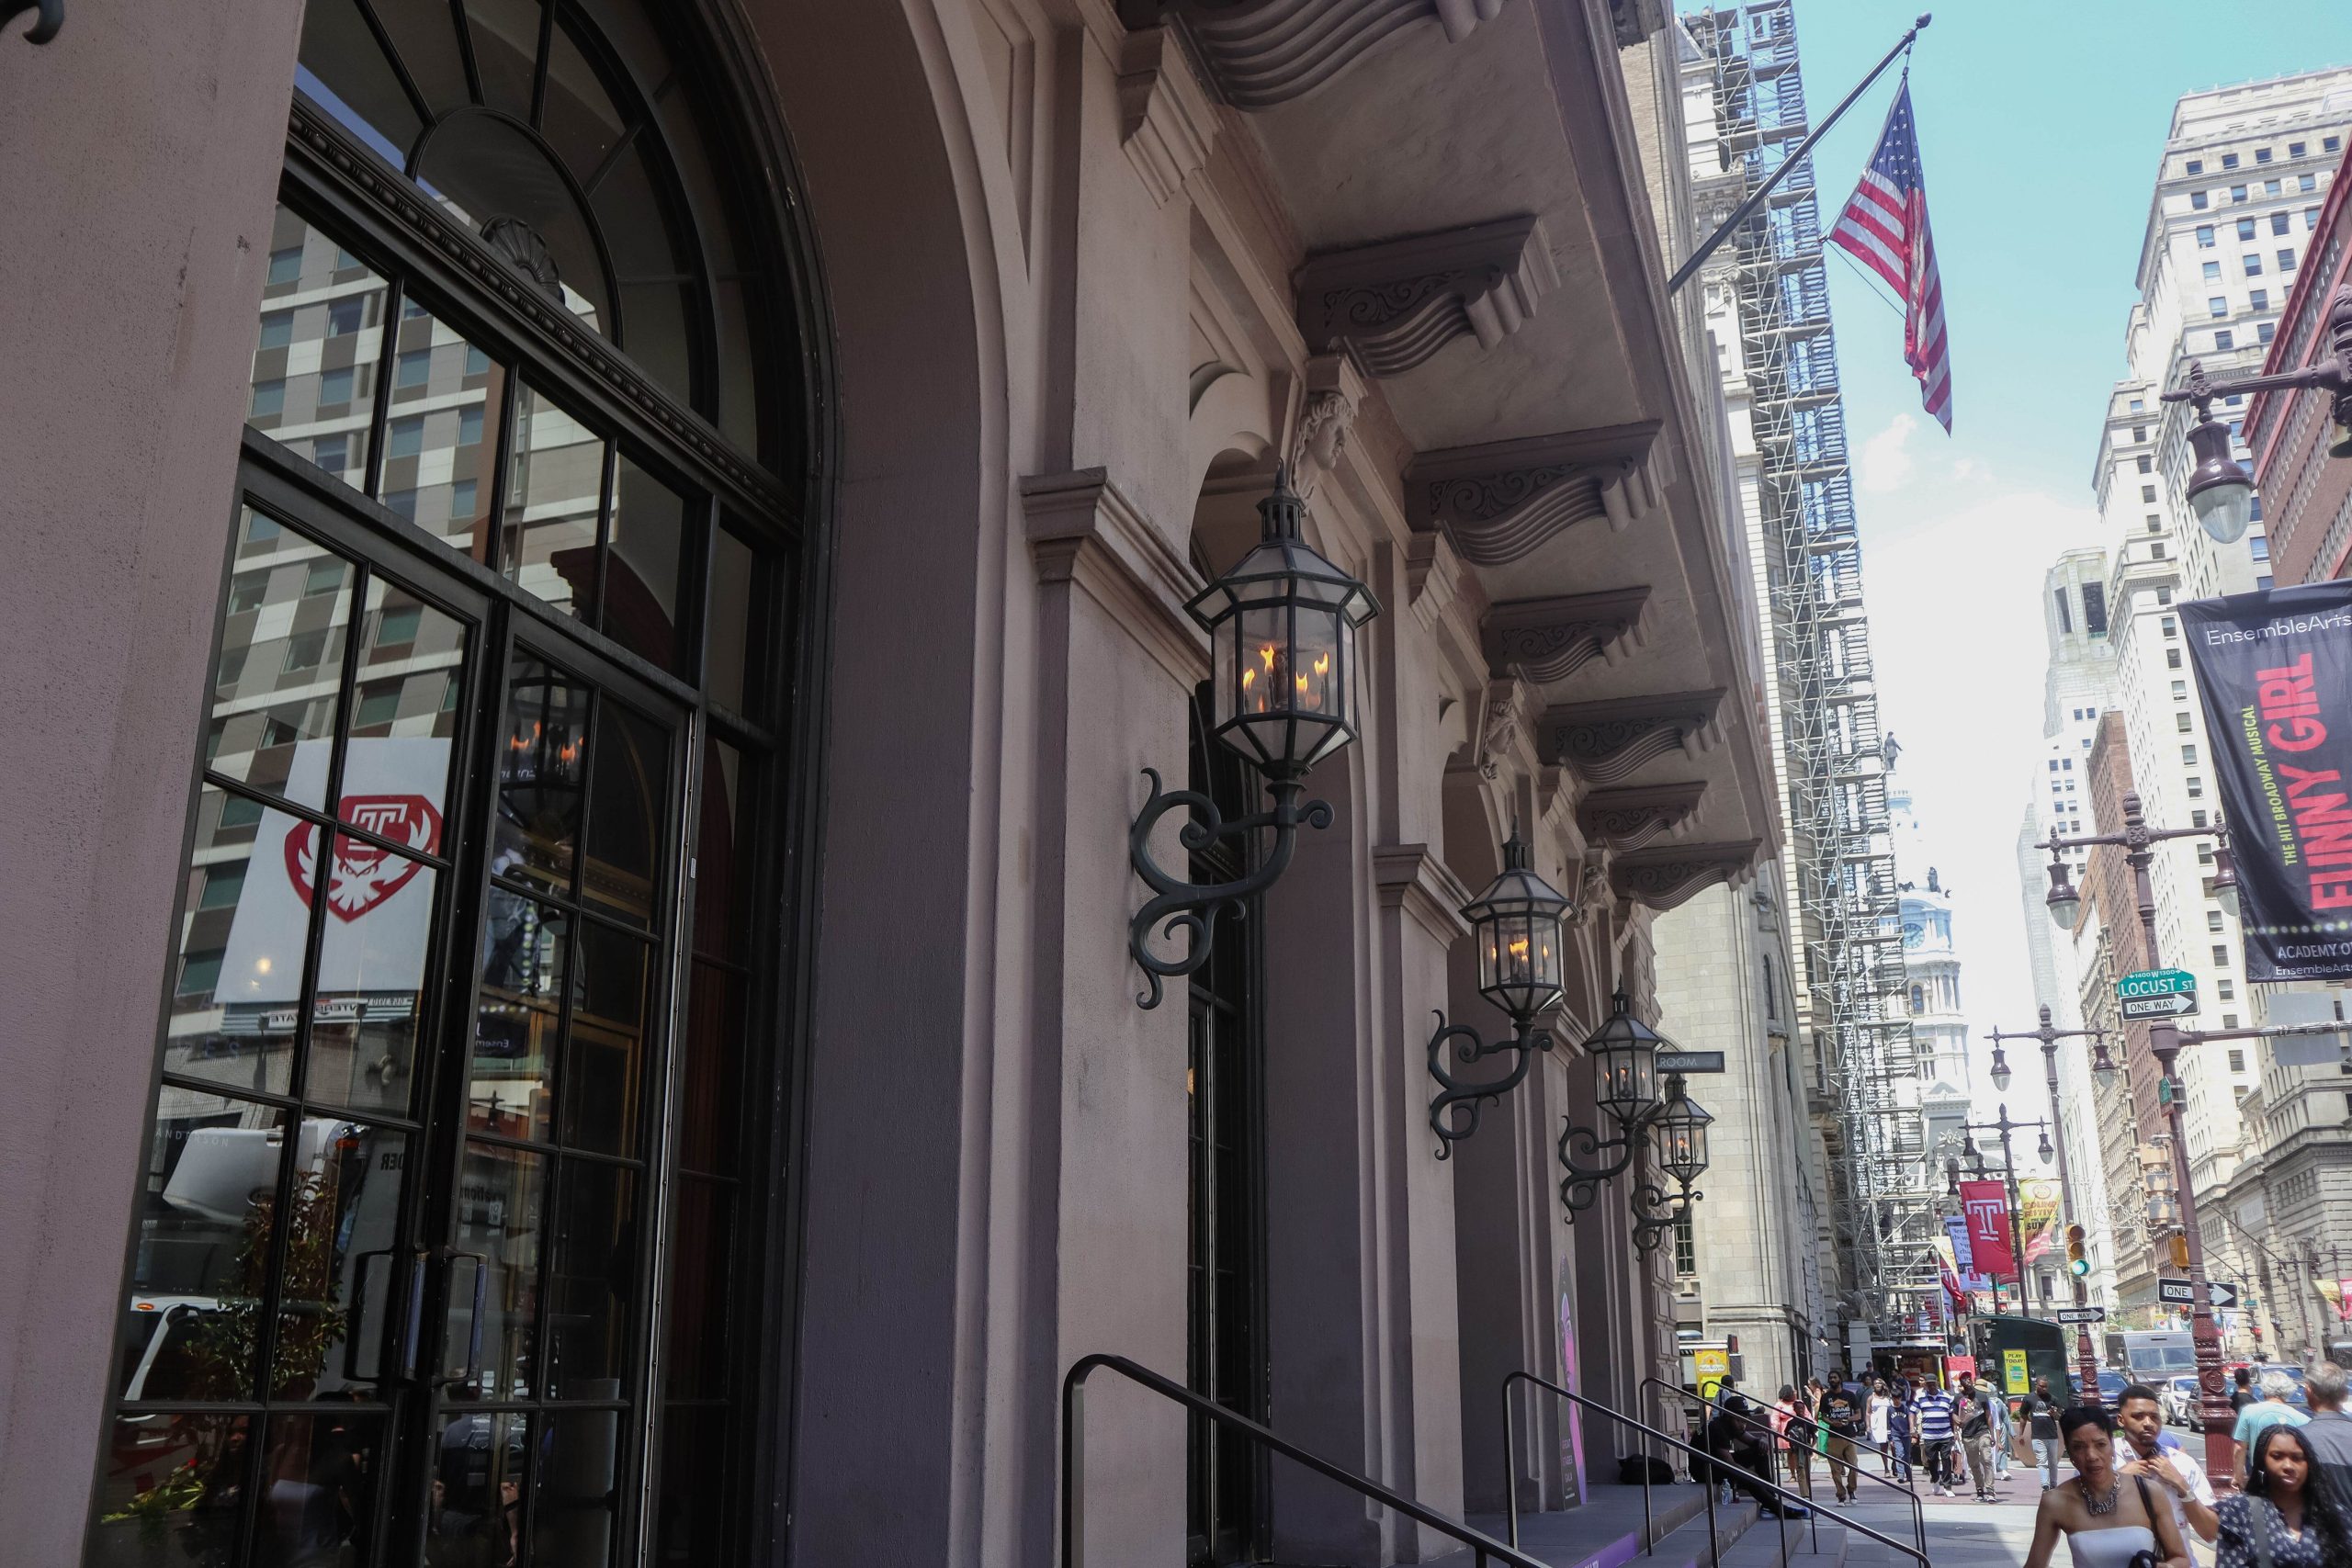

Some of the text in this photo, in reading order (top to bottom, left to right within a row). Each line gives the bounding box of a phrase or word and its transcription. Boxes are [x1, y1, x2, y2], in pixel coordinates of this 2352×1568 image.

[2242, 705, 2298, 866] THE HIT BROADWAY MUSICAL
[2256, 652, 2352, 909] FUNNY GIRL
[2278, 942, 2352, 959] ACADEMY O
[2120, 977, 2193, 997] LOCUST ST
[2130, 999, 2175, 1012] ONE WAY
[2166, 1286, 2188, 1297] ONE
[2062, 1312, 2076, 1320] ONE
